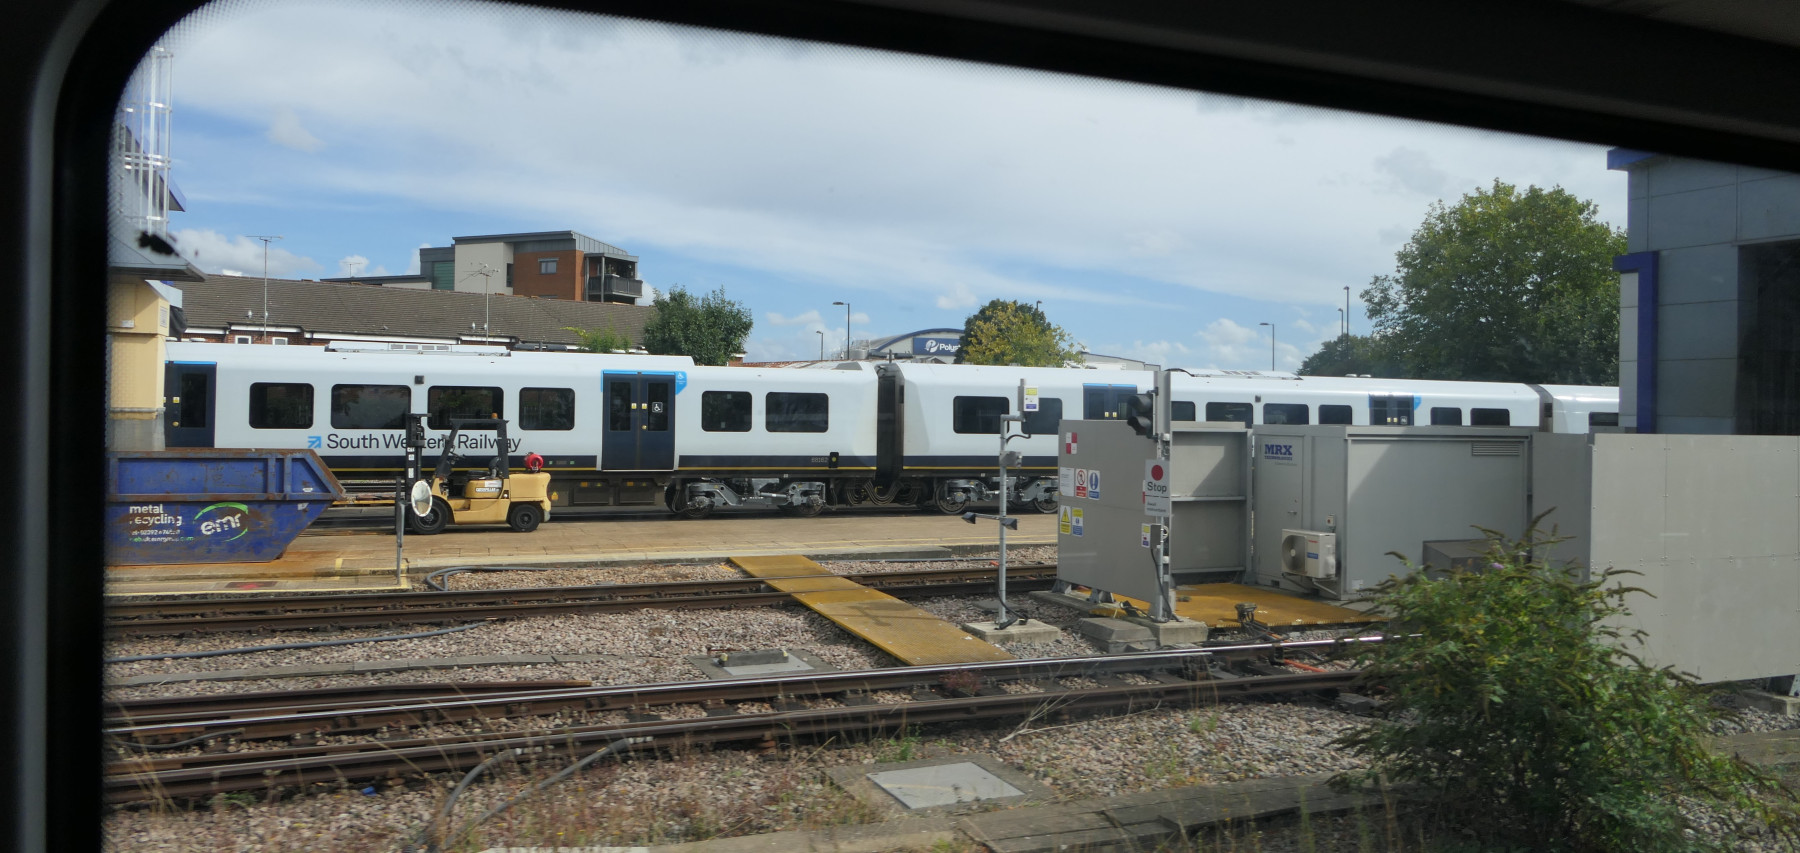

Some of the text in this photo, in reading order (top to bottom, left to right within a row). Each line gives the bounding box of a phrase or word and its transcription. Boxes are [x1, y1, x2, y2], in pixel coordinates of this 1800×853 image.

[327, 433, 380, 449] South
[1264, 444, 1293, 456] MRX
[1147, 481, 1167, 494] Stop
[129, 504, 164, 514] metal
[200, 513, 242, 535] emr
